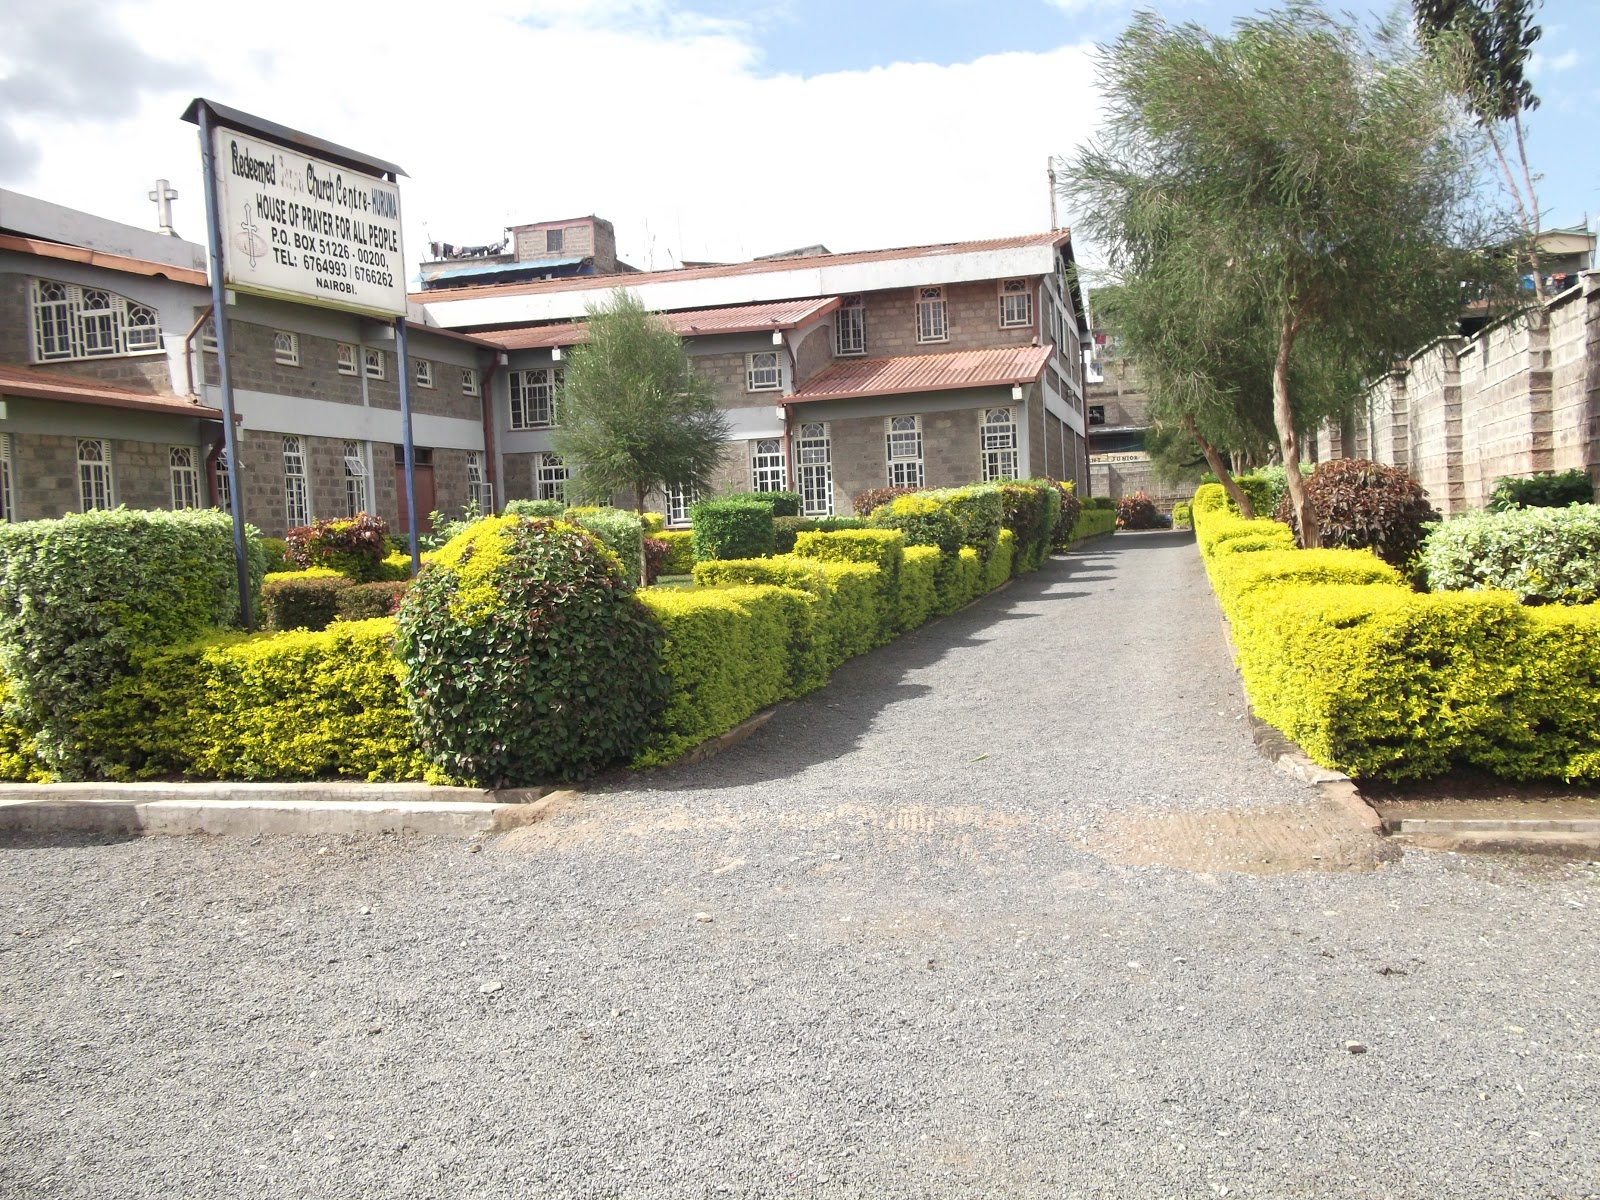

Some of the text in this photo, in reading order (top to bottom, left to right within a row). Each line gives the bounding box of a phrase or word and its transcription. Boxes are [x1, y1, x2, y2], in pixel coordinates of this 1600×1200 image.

[231, 140, 276, 190] Redeemed
[306, 162, 335, 209] Church
[256, 192, 398, 253] HOUSE OF PRAYER FOR ALL PEOPLE
[271, 226, 291, 246] P.O.
[294, 233, 316, 253] BOX
[319, 238, 350, 260] 51226
[357, 248, 389, 272] 00200,
[273, 247, 298, 268] TEL:
[303, 254, 347, 278] 6764993
[355, 267, 394, 288] 6766262
[316, 277, 358, 296] NAIROBI.
